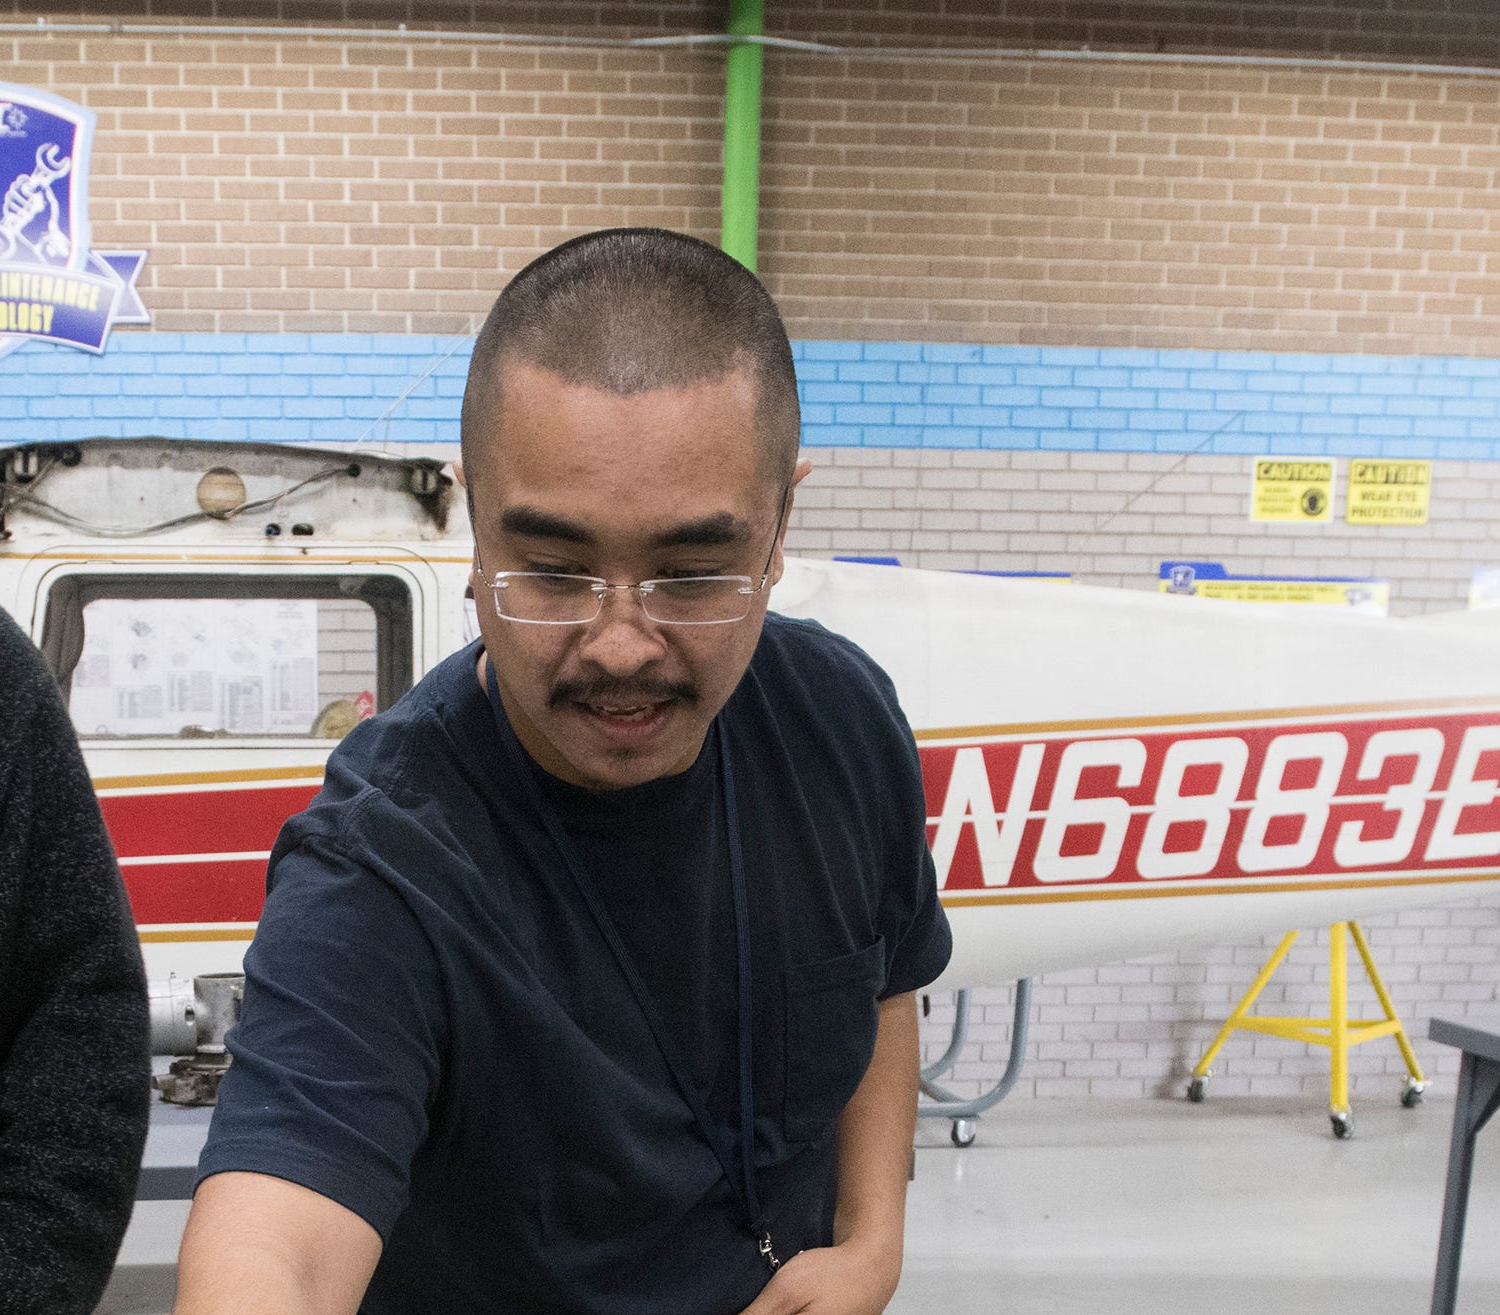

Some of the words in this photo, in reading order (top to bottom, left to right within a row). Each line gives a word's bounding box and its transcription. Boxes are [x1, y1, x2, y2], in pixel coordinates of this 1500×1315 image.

[1259, 463, 1330, 481] CAUTION
[1353, 464, 1429, 484] CAUTION
[1361, 491, 1392, 501] WEAR
[1397, 491, 1418, 501] EYE
[1351, 506, 1426, 518] PROTECTION
